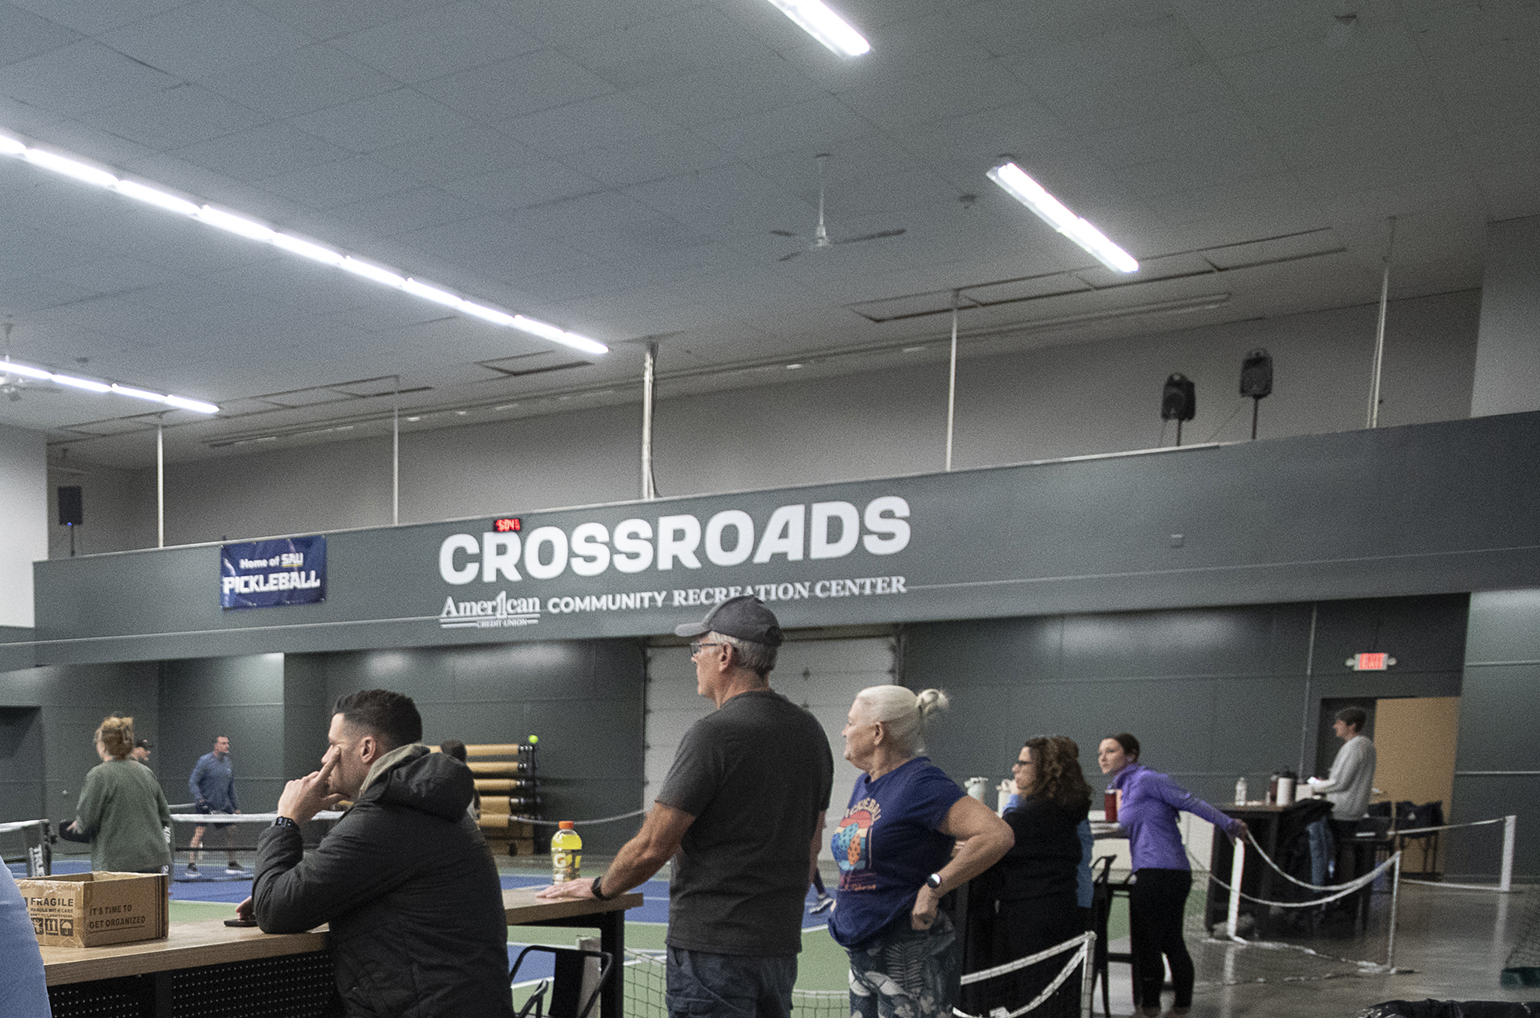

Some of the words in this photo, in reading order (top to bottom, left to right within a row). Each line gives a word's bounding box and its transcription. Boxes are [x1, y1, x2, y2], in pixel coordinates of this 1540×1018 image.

[438, 495, 912, 586] CROSSROADS
[239, 558, 268, 569] Home
[269, 555, 280, 567] of
[222, 569, 321, 595] PICKLEBALL
[547, 590, 667, 614] COMMUNITY
[671, 581, 812, 607] RECREATION
[814, 575, 908, 598] CENTER
[30, 897, 74, 907] FRAGILE
[104, 905, 122, 915] TIME
[123, 904, 133, 913] TO
[89, 920, 104, 929] GET
[104, 915, 146, 928] ORGANIZED
